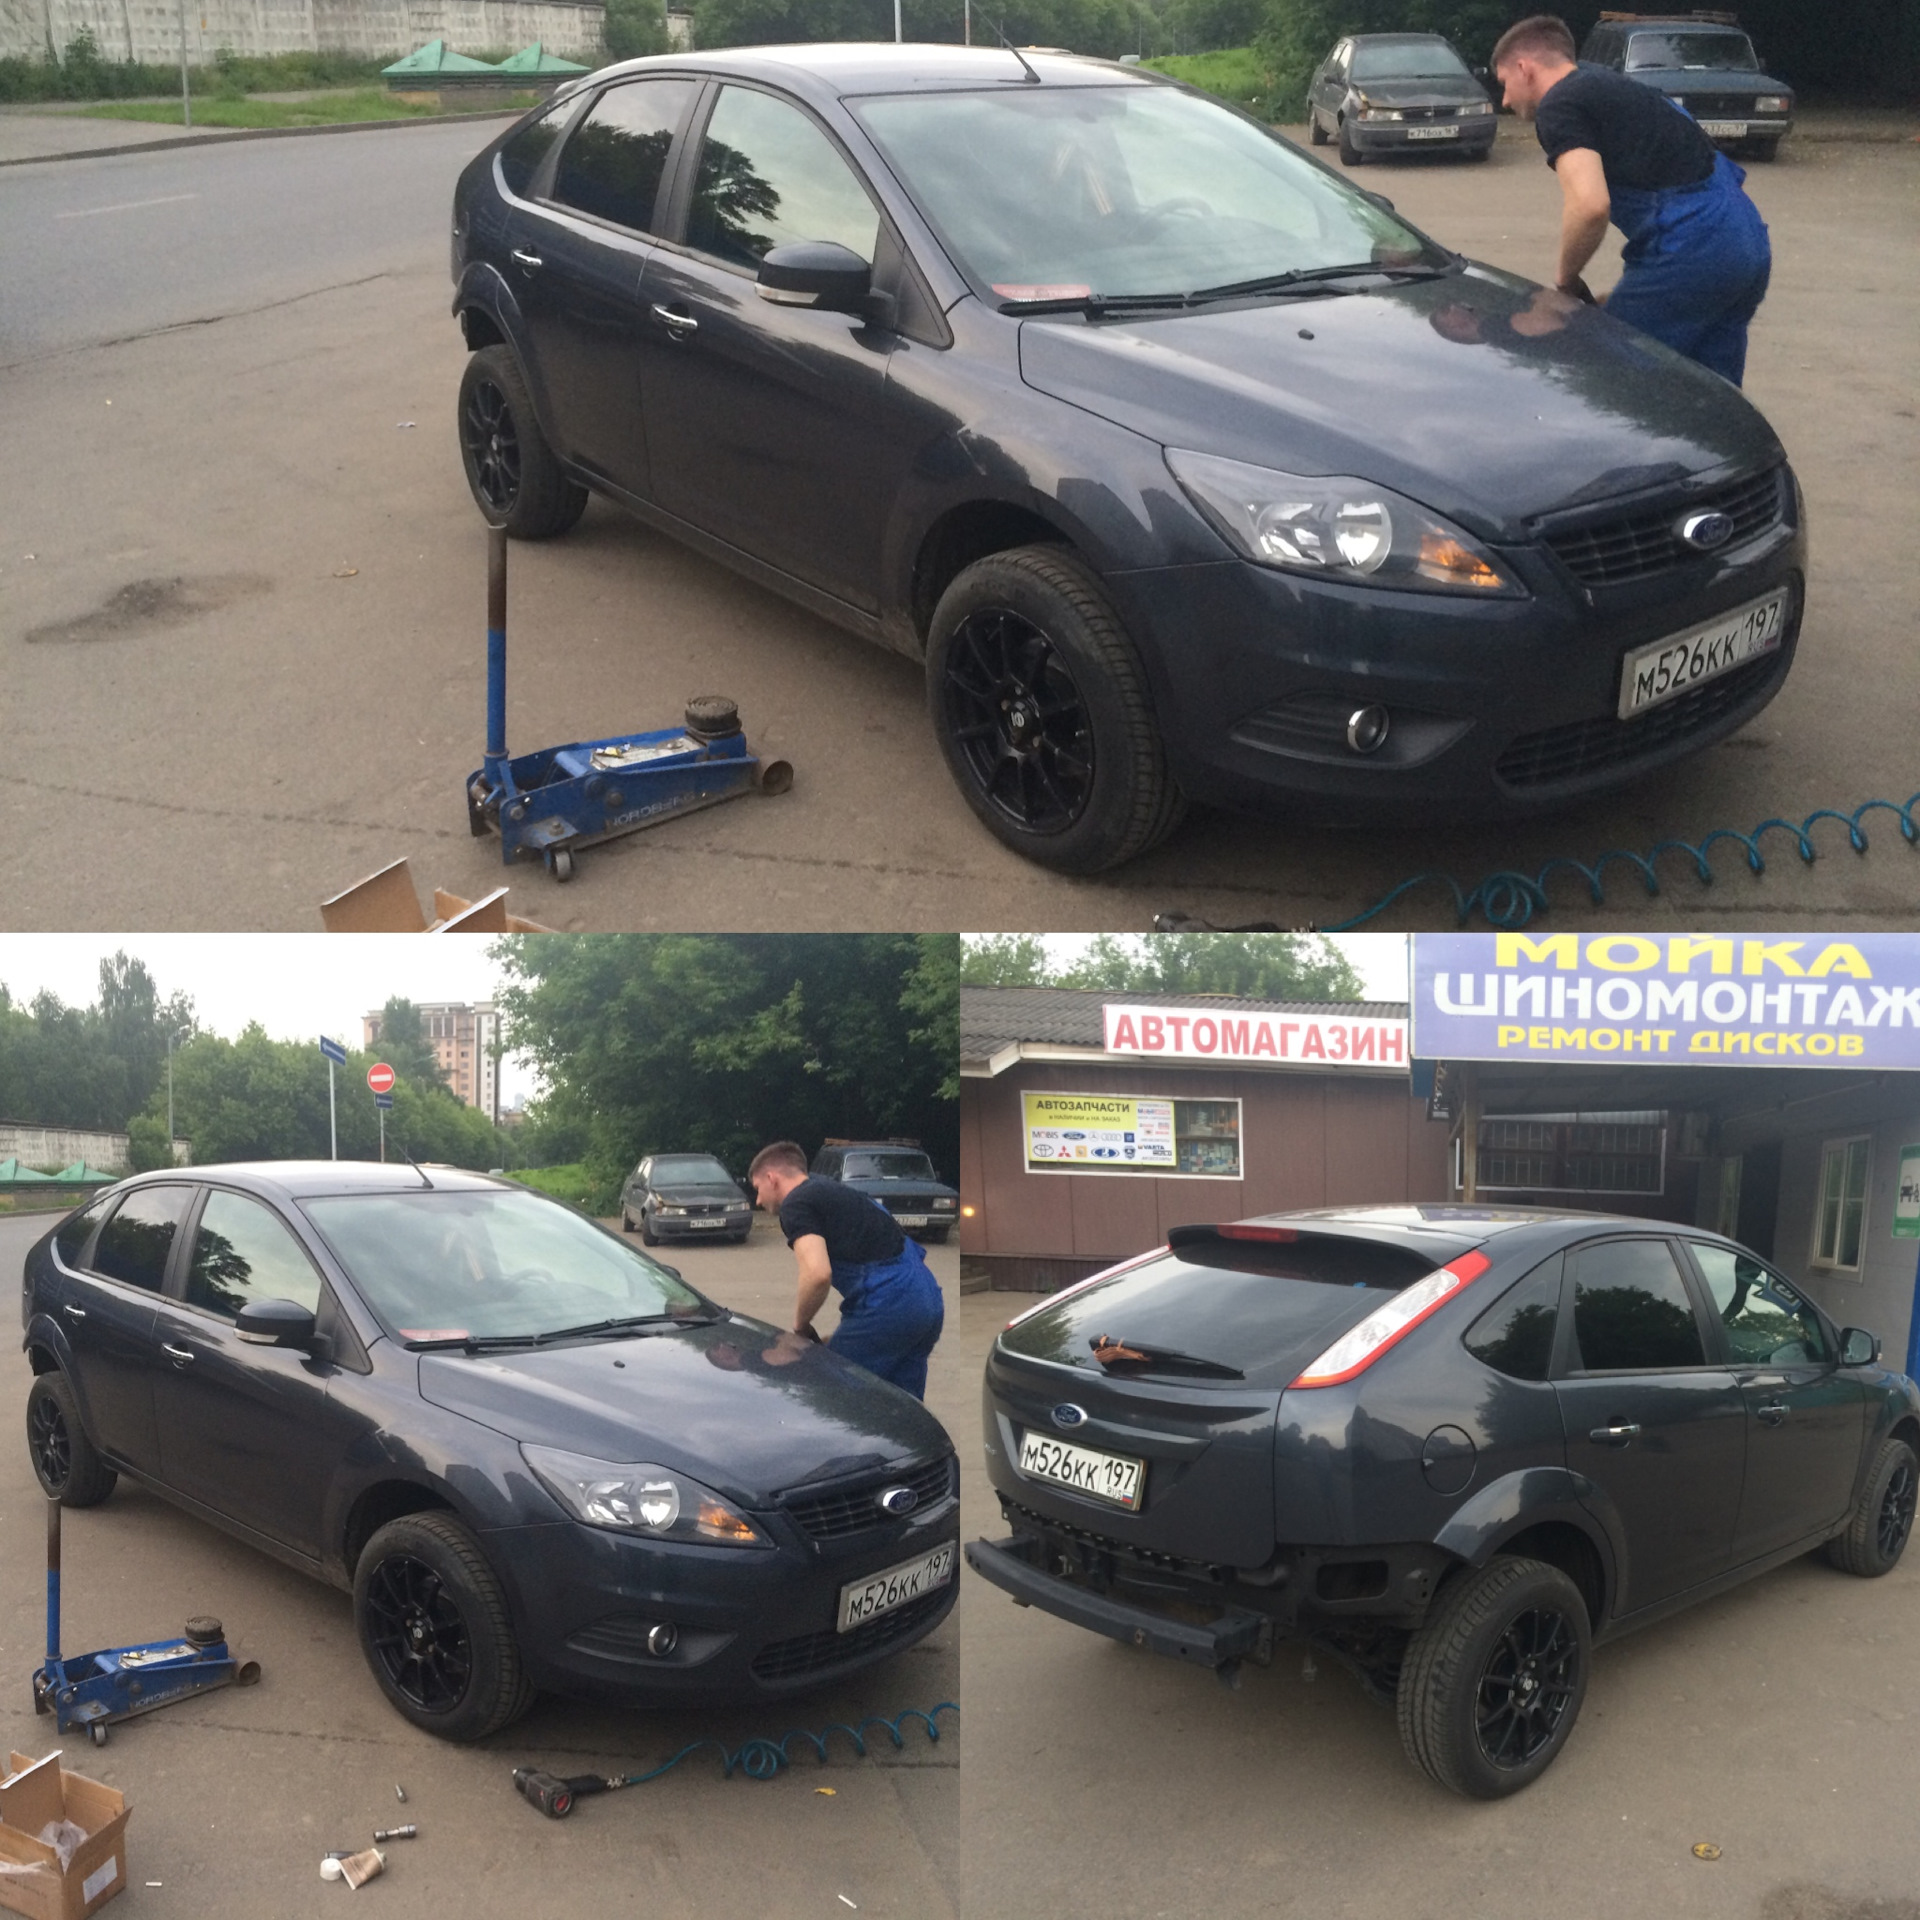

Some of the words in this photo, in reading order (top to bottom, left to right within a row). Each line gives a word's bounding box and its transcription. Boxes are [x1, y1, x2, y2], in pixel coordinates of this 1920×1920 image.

[1745, 602, 1778, 641] 197
[1496, 933, 1872, 979] МОЙКА
[1433, 972, 1920, 1027] ШИНОМОНТАЖ
[1113, 1014, 1403, 1062] АВТОМАГАЗИН
[1497, 1025, 1676, 1052] РЕМОНТ
[1688, 1029, 1864, 1056] ДИСКОВ
[1036, 1100, 1130, 1113] АВТОЗАПЧАСТИ
[1105, 1460, 1135, 1490] 197
[1107, 1486, 1122, 1501] RUS
[926, 1551, 949, 1579] 197
